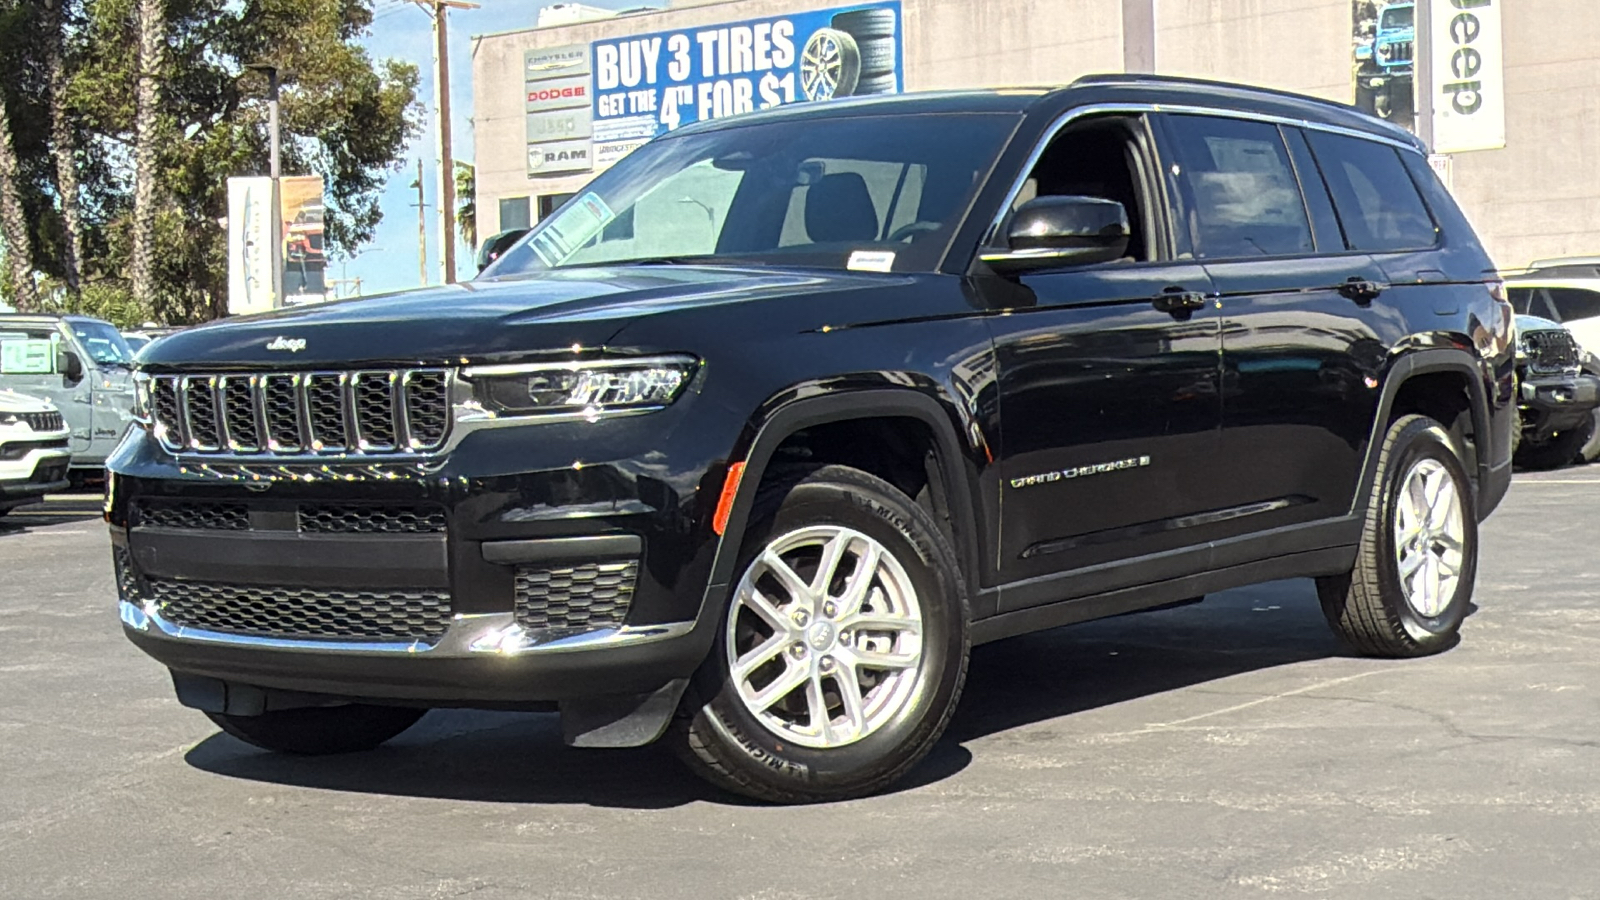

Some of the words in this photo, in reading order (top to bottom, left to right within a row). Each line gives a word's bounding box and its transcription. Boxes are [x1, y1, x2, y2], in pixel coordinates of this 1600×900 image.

[597, 37, 661, 89] BUY
[668, 34, 690, 81] 3
[697, 20, 795, 77] TIRES
[528, 86, 585, 101] DODGE
[598, 93, 626, 117] GET
[628, 89, 657, 113] THE
[698, 78, 753, 121] FOR
[759, 72, 795, 110] $1
[545, 150, 586, 162] RAM
[266, 336, 306, 352] Jeep
[1010, 471, 1060, 489] GRAND
[1064, 458, 1138, 478] CHEROKEE
